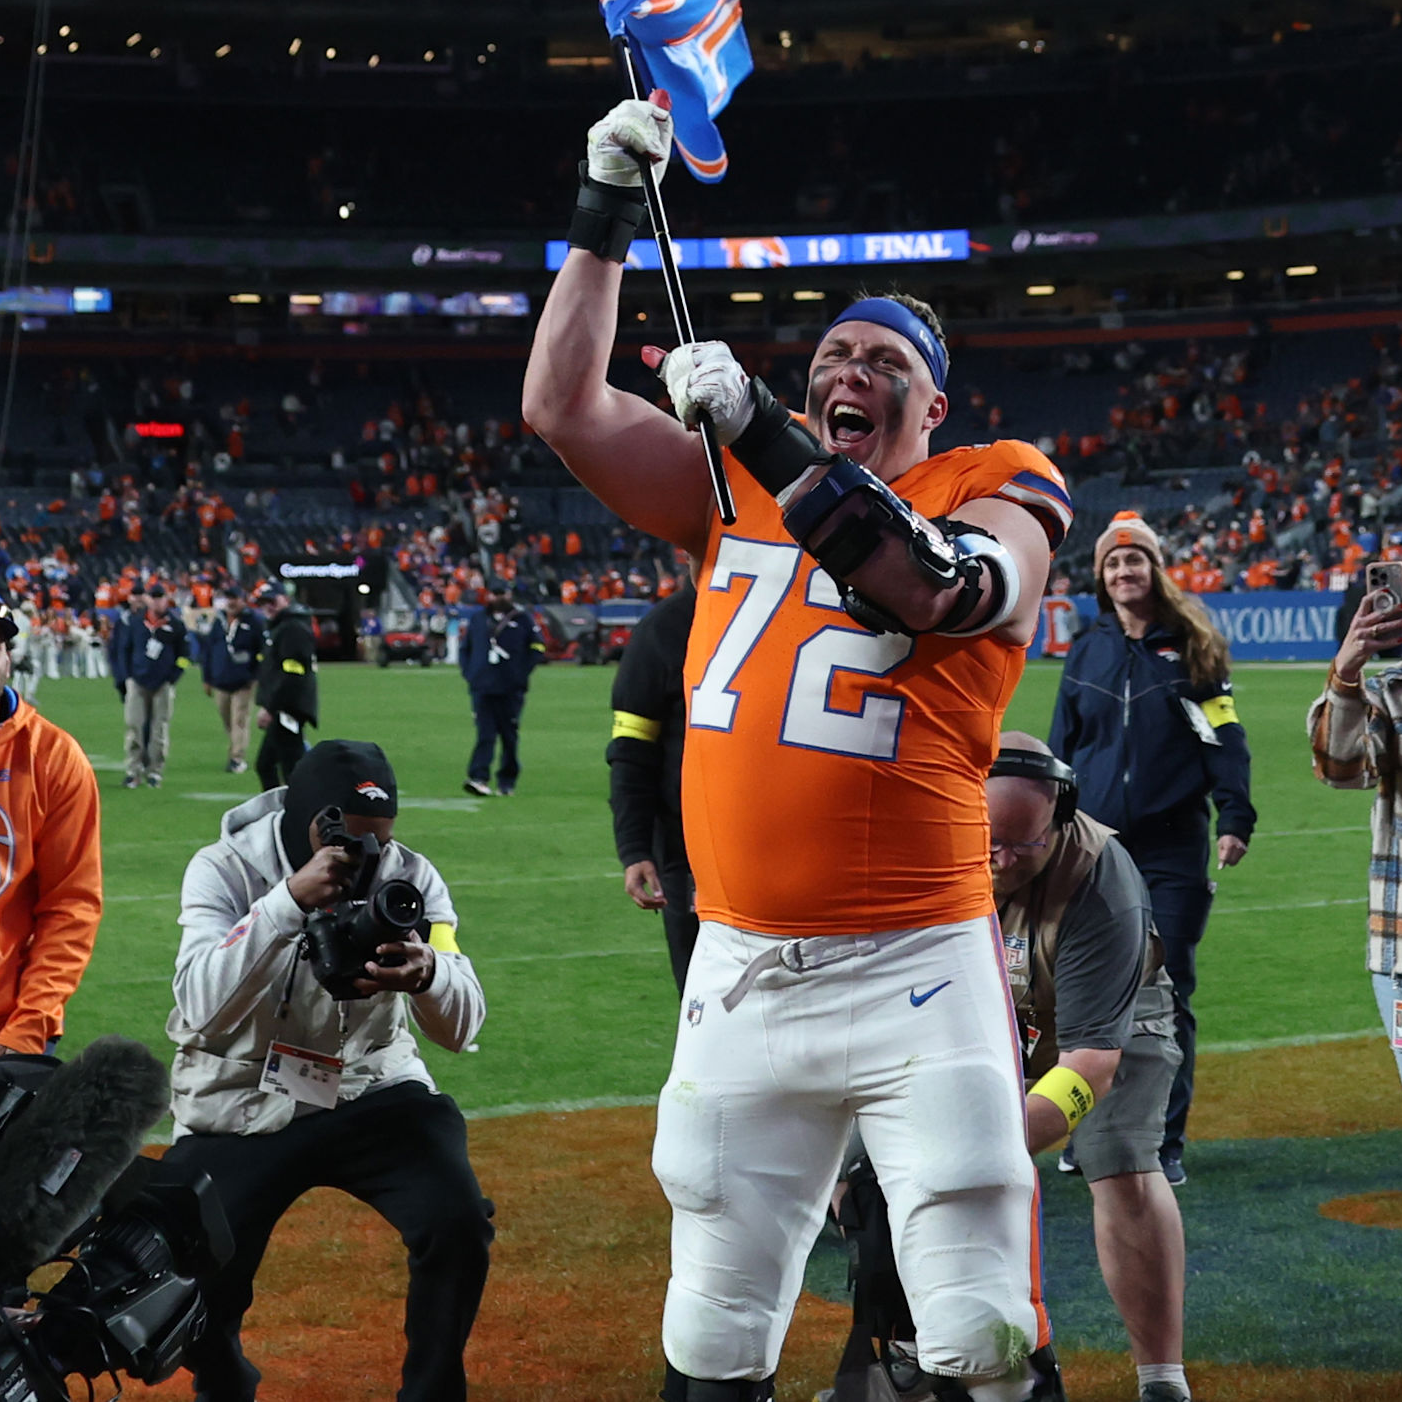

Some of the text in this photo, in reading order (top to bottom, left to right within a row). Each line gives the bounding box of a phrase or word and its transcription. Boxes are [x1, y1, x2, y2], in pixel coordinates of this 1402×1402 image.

[807, 238, 840, 262] 19
[864, 233, 952, 260] FINAL
[689, 534, 915, 761] 72
